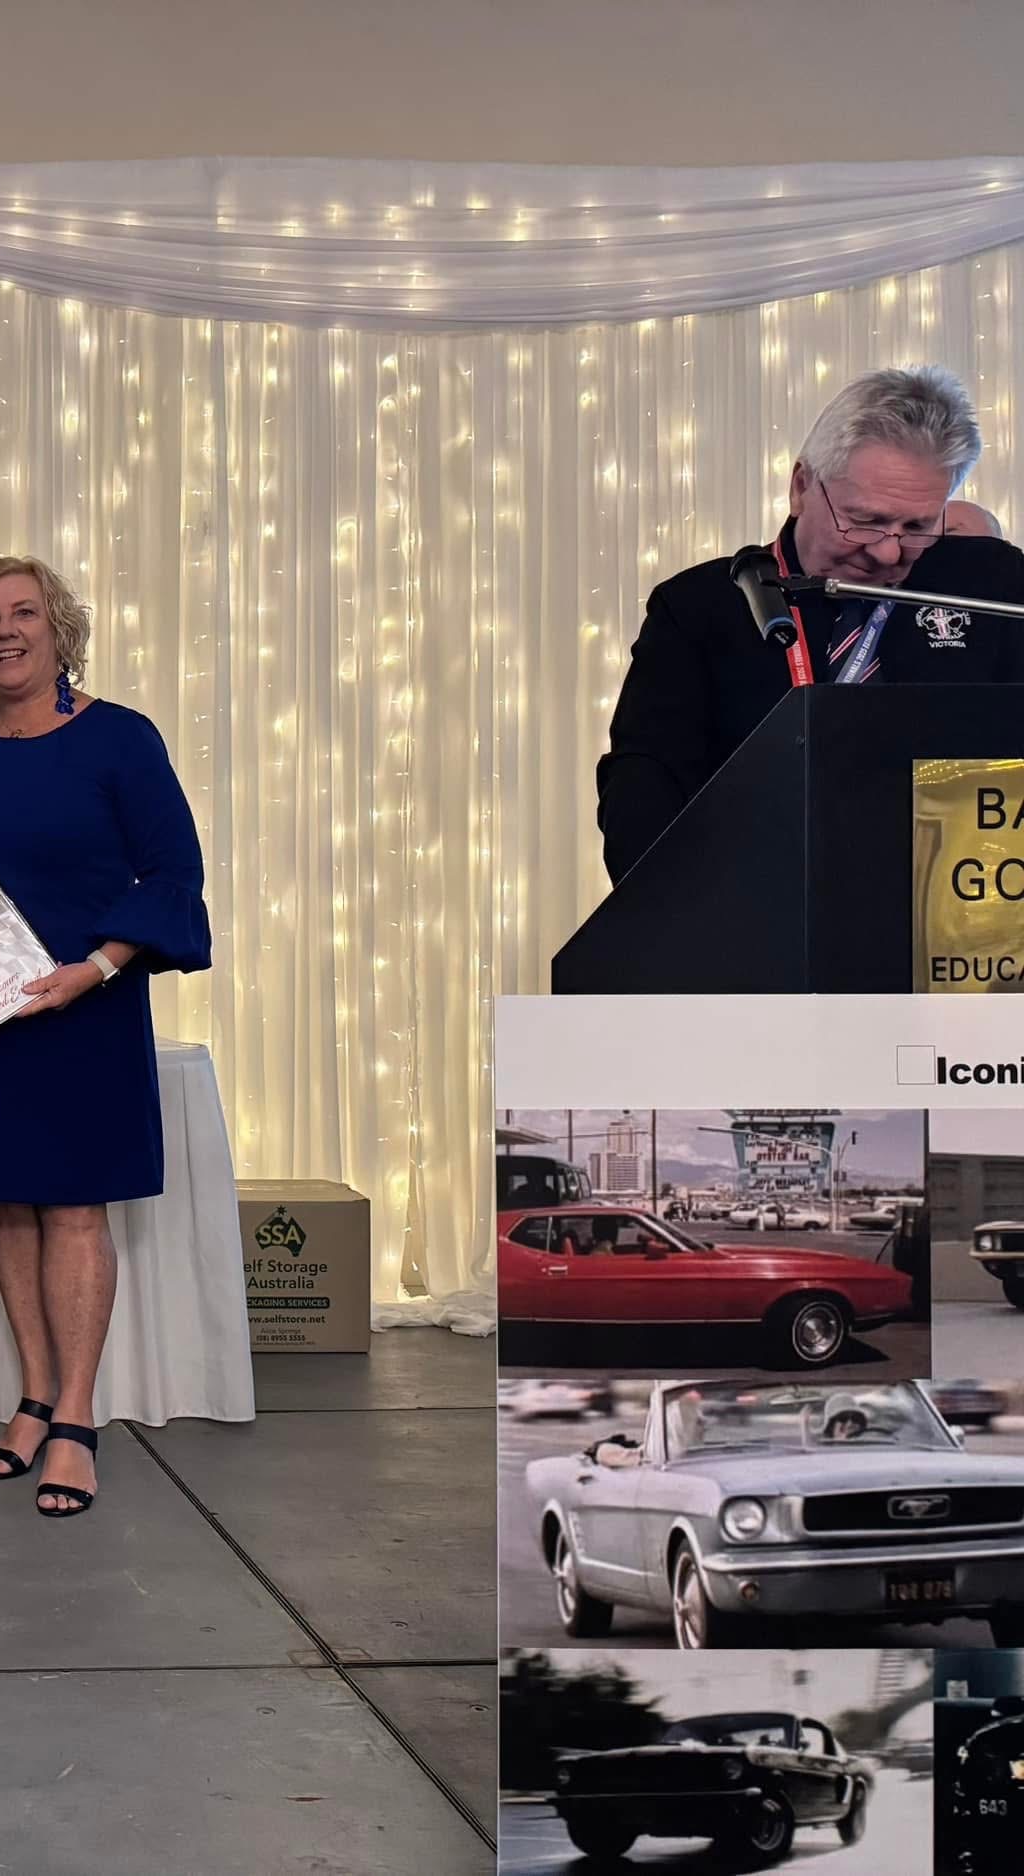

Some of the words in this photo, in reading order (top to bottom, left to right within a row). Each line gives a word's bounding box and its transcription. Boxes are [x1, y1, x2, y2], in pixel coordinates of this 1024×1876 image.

[258, 1225, 302, 1245] SSA
[243, 1259, 264, 1273] elf
[267, 1260, 328, 1276] Storage
[247, 1276, 314, 1289] Australia
[979, 1799, 1008, 1816] 643
